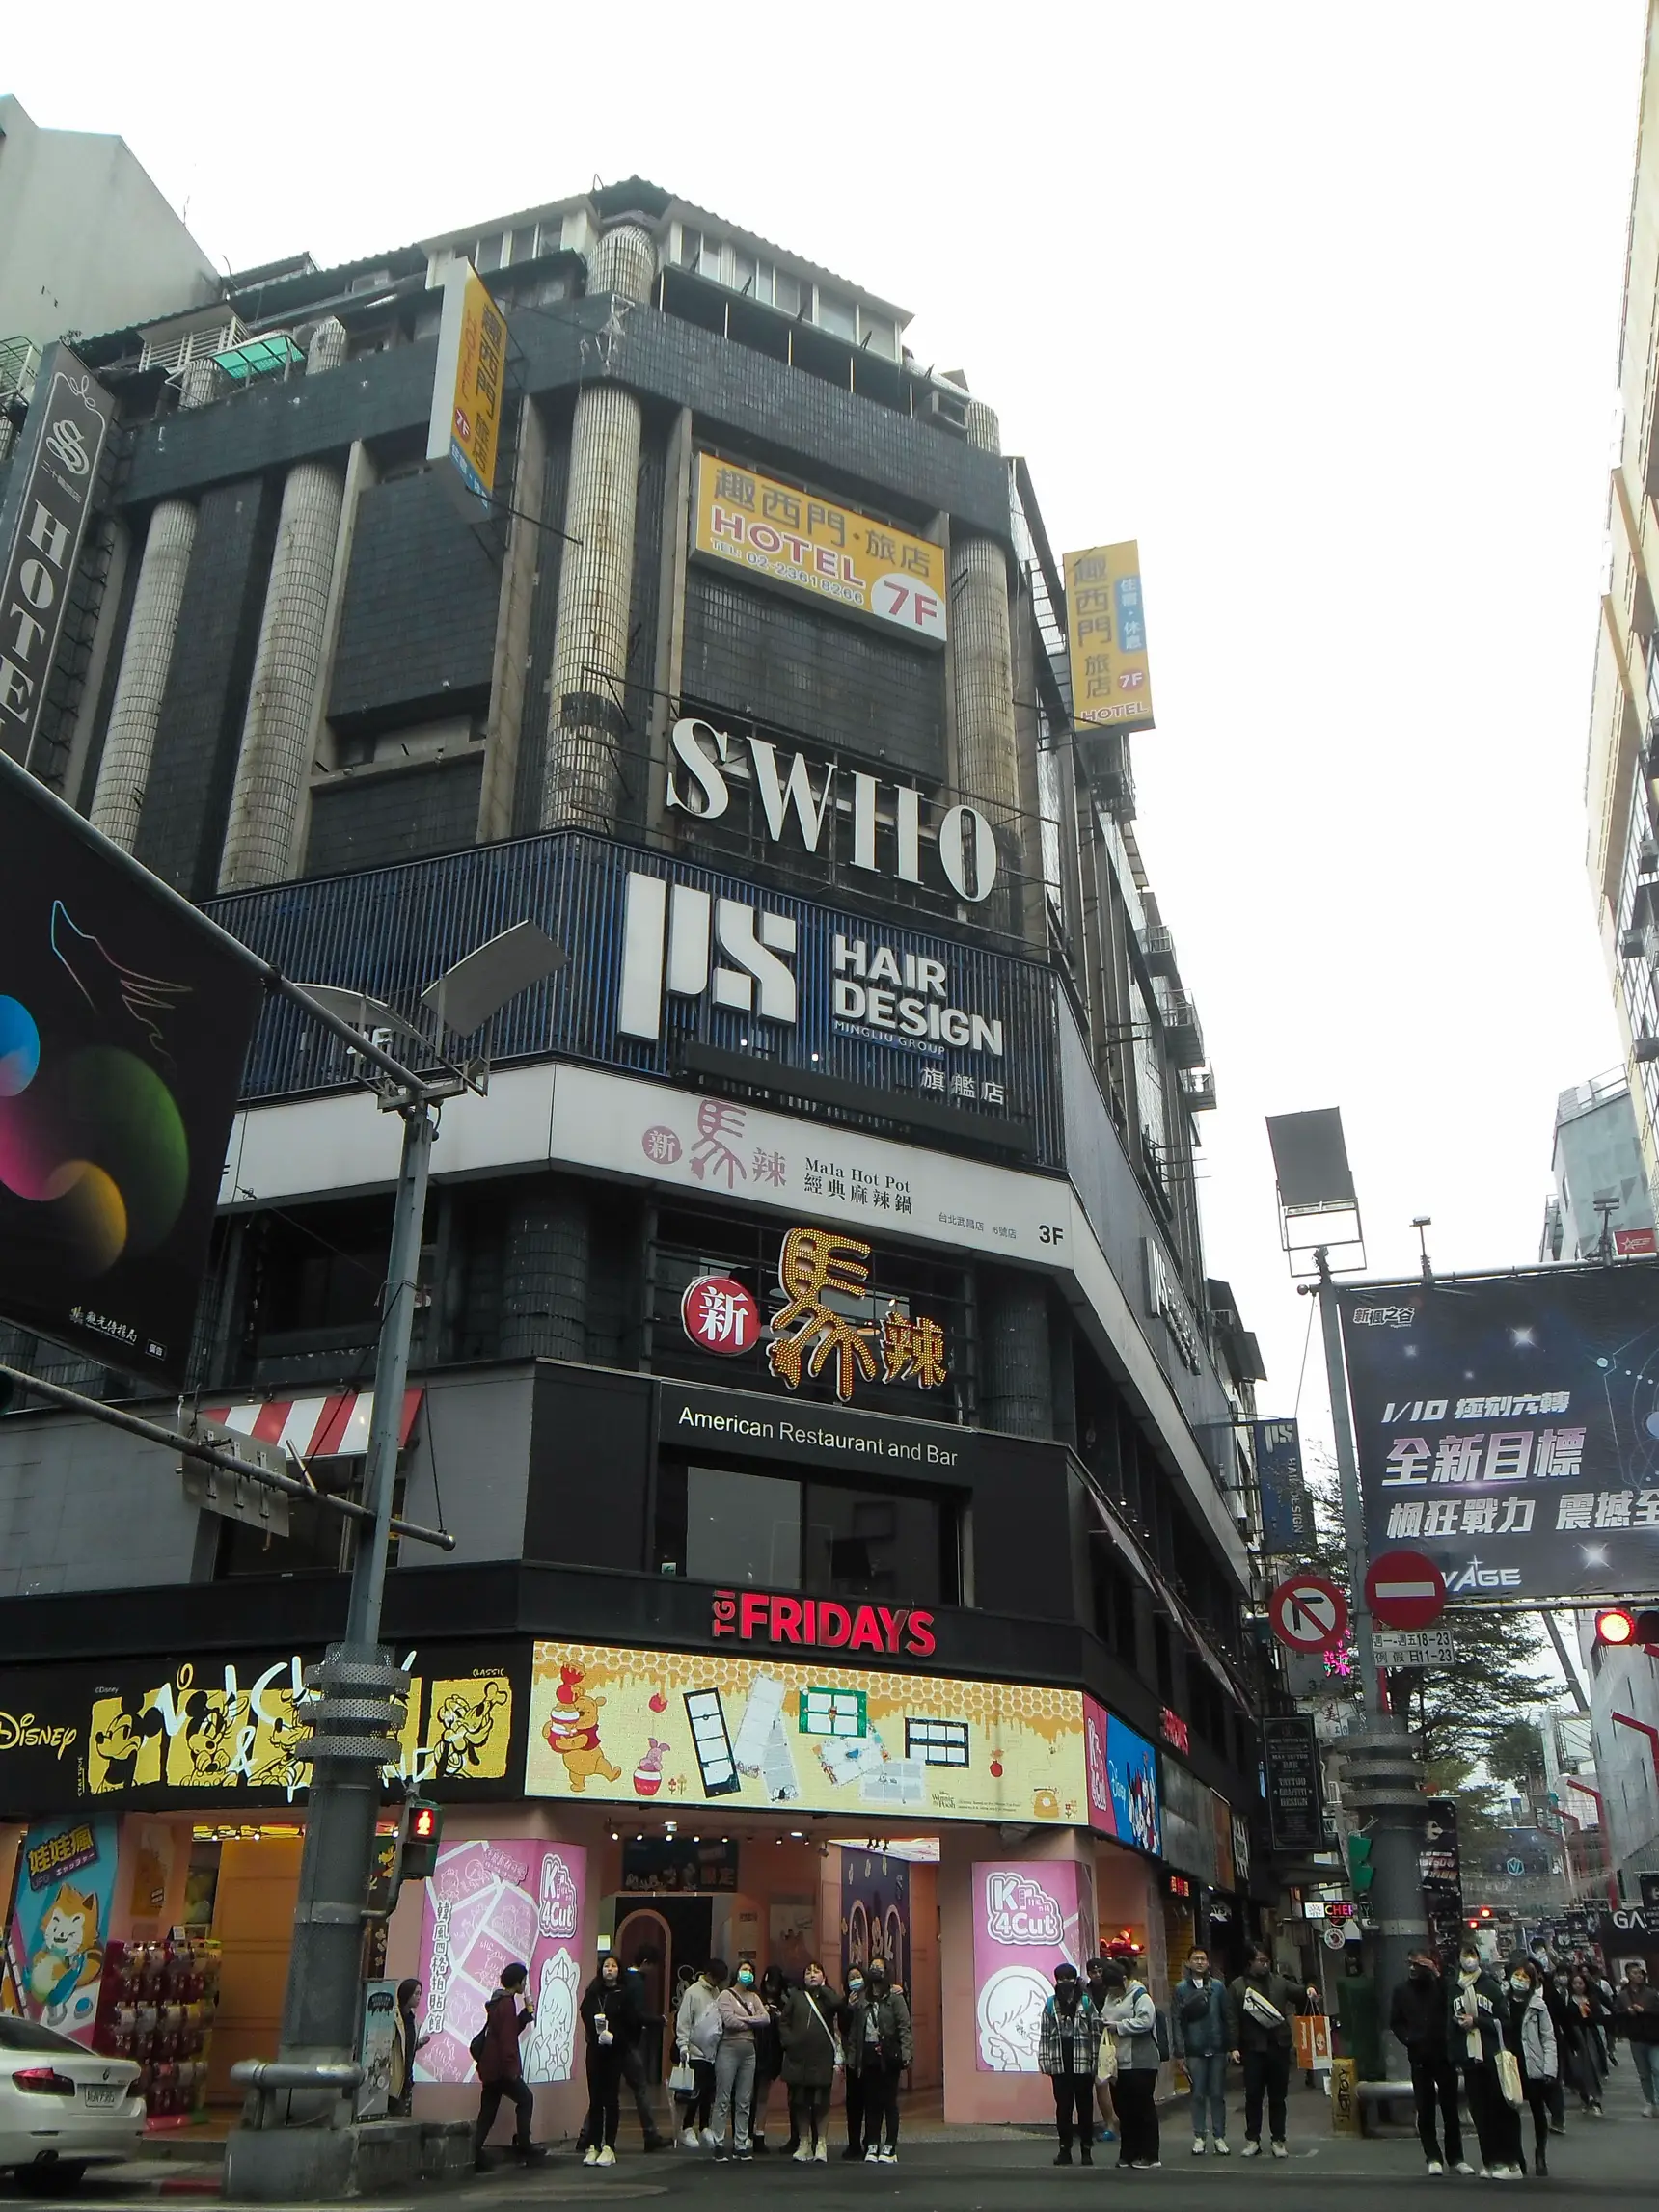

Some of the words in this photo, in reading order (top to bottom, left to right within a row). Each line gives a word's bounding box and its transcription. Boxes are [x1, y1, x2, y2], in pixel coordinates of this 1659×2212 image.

[711, 505, 866, 589] HOTEL
[0, 499, 71, 729] HOTE
[884, 580, 937, 626] 7F
[1119, 673, 1143, 688] 7F
[1080, 703, 1148, 723] HOTEL
[833, 934, 947, 999] HAIR
[833, 979, 1002, 1056] DESIGN
[835, 1021, 893, 1042] MINGLIU
[899, 1035, 945, 1056] GROUP
[921, 1067, 1004, 1105] 旗艦店
[805, 1157, 844, 1179] Mala
[852, 1169, 879, 1185] Hot
[885, 1176, 911, 1193] Pot
[804, 1173, 912, 1215] 經典麻辣鍋
[938, 1212, 984, 1232] 台北武昌店
[1039, 1225, 1063, 1245] 3F
[1353, 1306, 1415, 1326] 新楓之谷
[1381, 1400, 1448, 1423] 1/10
[678, 1406, 774, 1439] American
[779, 1422, 884, 1456] Restaurant
[888, 1441, 922, 1462] and
[926, 1445, 959, 1467] Bar
[1381, 1427, 1587, 1486] 全新目標
[1386, 1497, 1536, 1539] 楓狂戰力
[1442, 1556, 1521, 1591] VAGE
[712, 1590, 736, 1637] TGI
[741, 1592, 936, 1657] FRIDAYS
[472, 1667, 504, 1677] CLASSIC
[543, 1901, 572, 1927] 4Cut
[995, 1913, 1055, 1934] 4Cut
